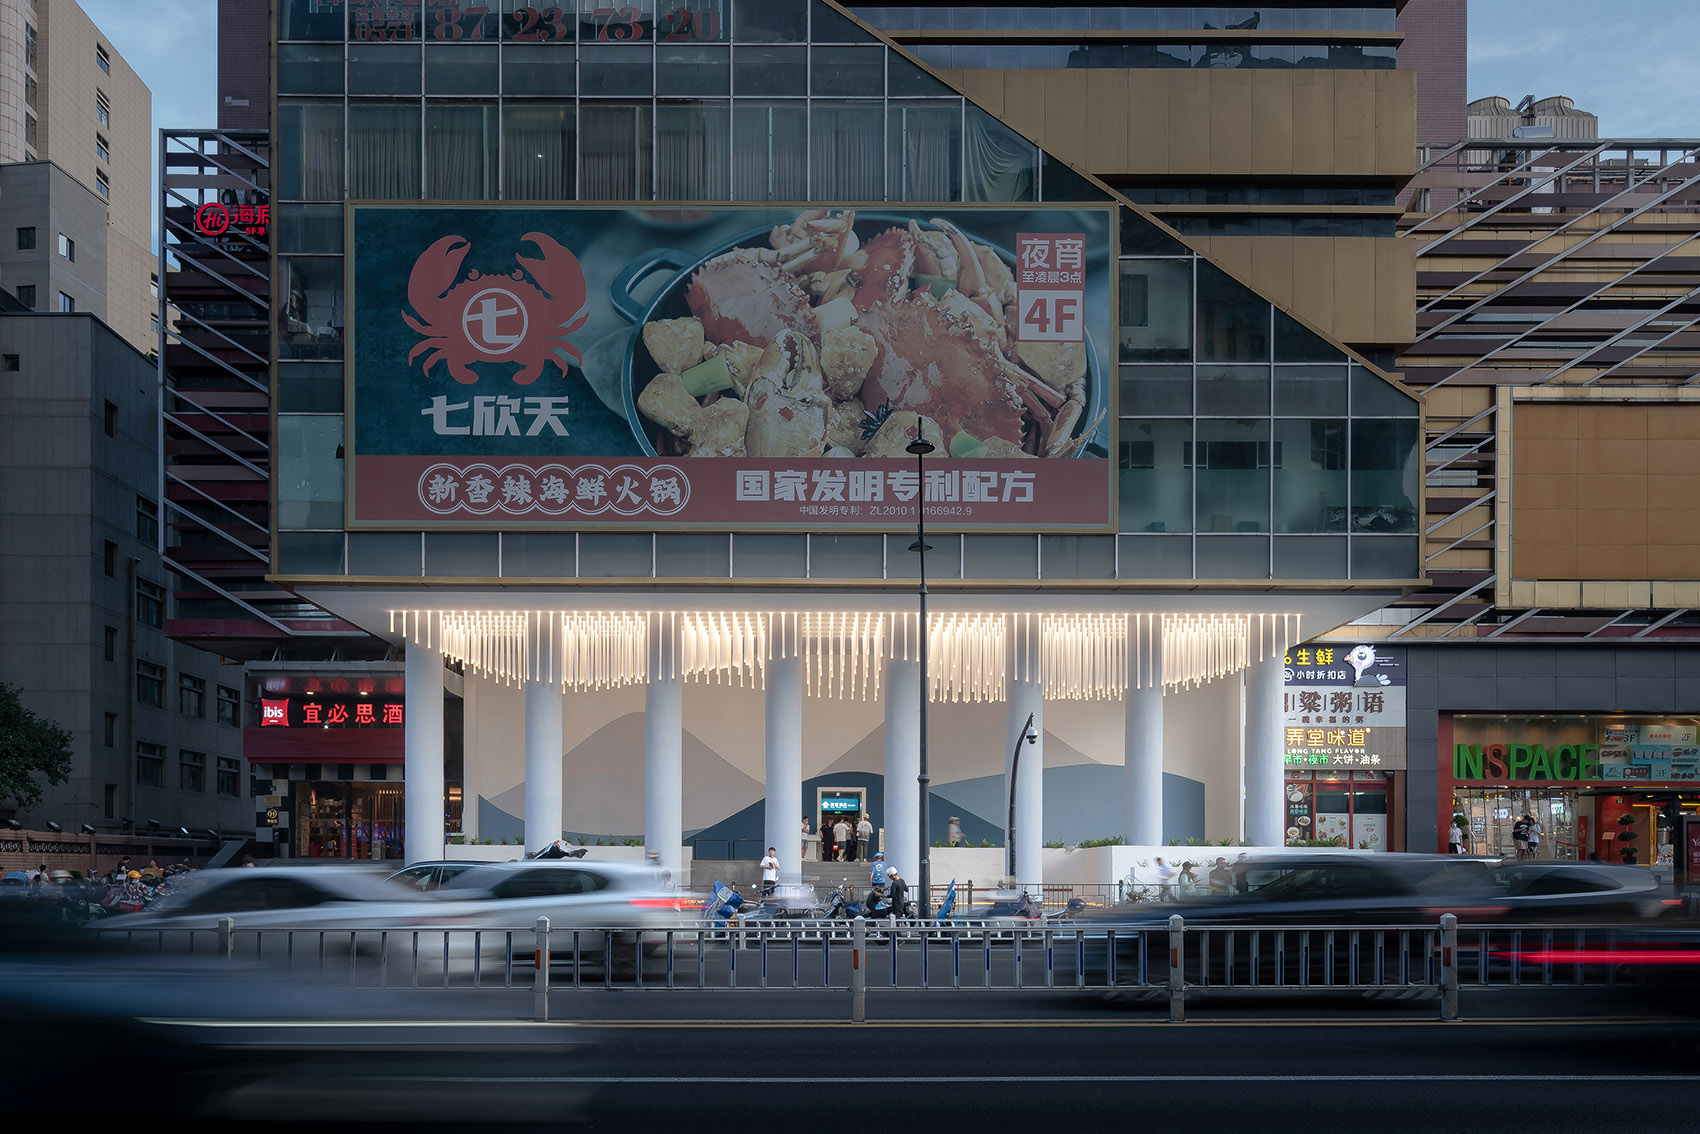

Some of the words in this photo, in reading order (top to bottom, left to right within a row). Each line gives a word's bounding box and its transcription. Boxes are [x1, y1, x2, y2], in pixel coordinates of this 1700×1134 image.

[355, 21, 412, 41] 0571
[433, 7, 489, 41] 87
[512, 6, 567, 41] 23
[590, 6, 644, 41] 73
[665, 7, 721, 41] 20
[1021, 238, 1083, 269] 夜宵
[1022, 271, 1082, 284] 至凌晨3点
[465, 297, 521, 344] 七
[1024, 298, 1078, 333] 4F
[421, 395, 570, 437] 七欣天
[428, 473, 681, 506] 新香辣海鲜火锅
[736, 469, 1036, 502] 国家发明专利配方
[869, 506, 908, 515] ZL2010
[263, 706, 284, 718] ibis
[303, 702, 403, 724] 宜必思酒
[1453, 743, 1600, 781] INSPACE
